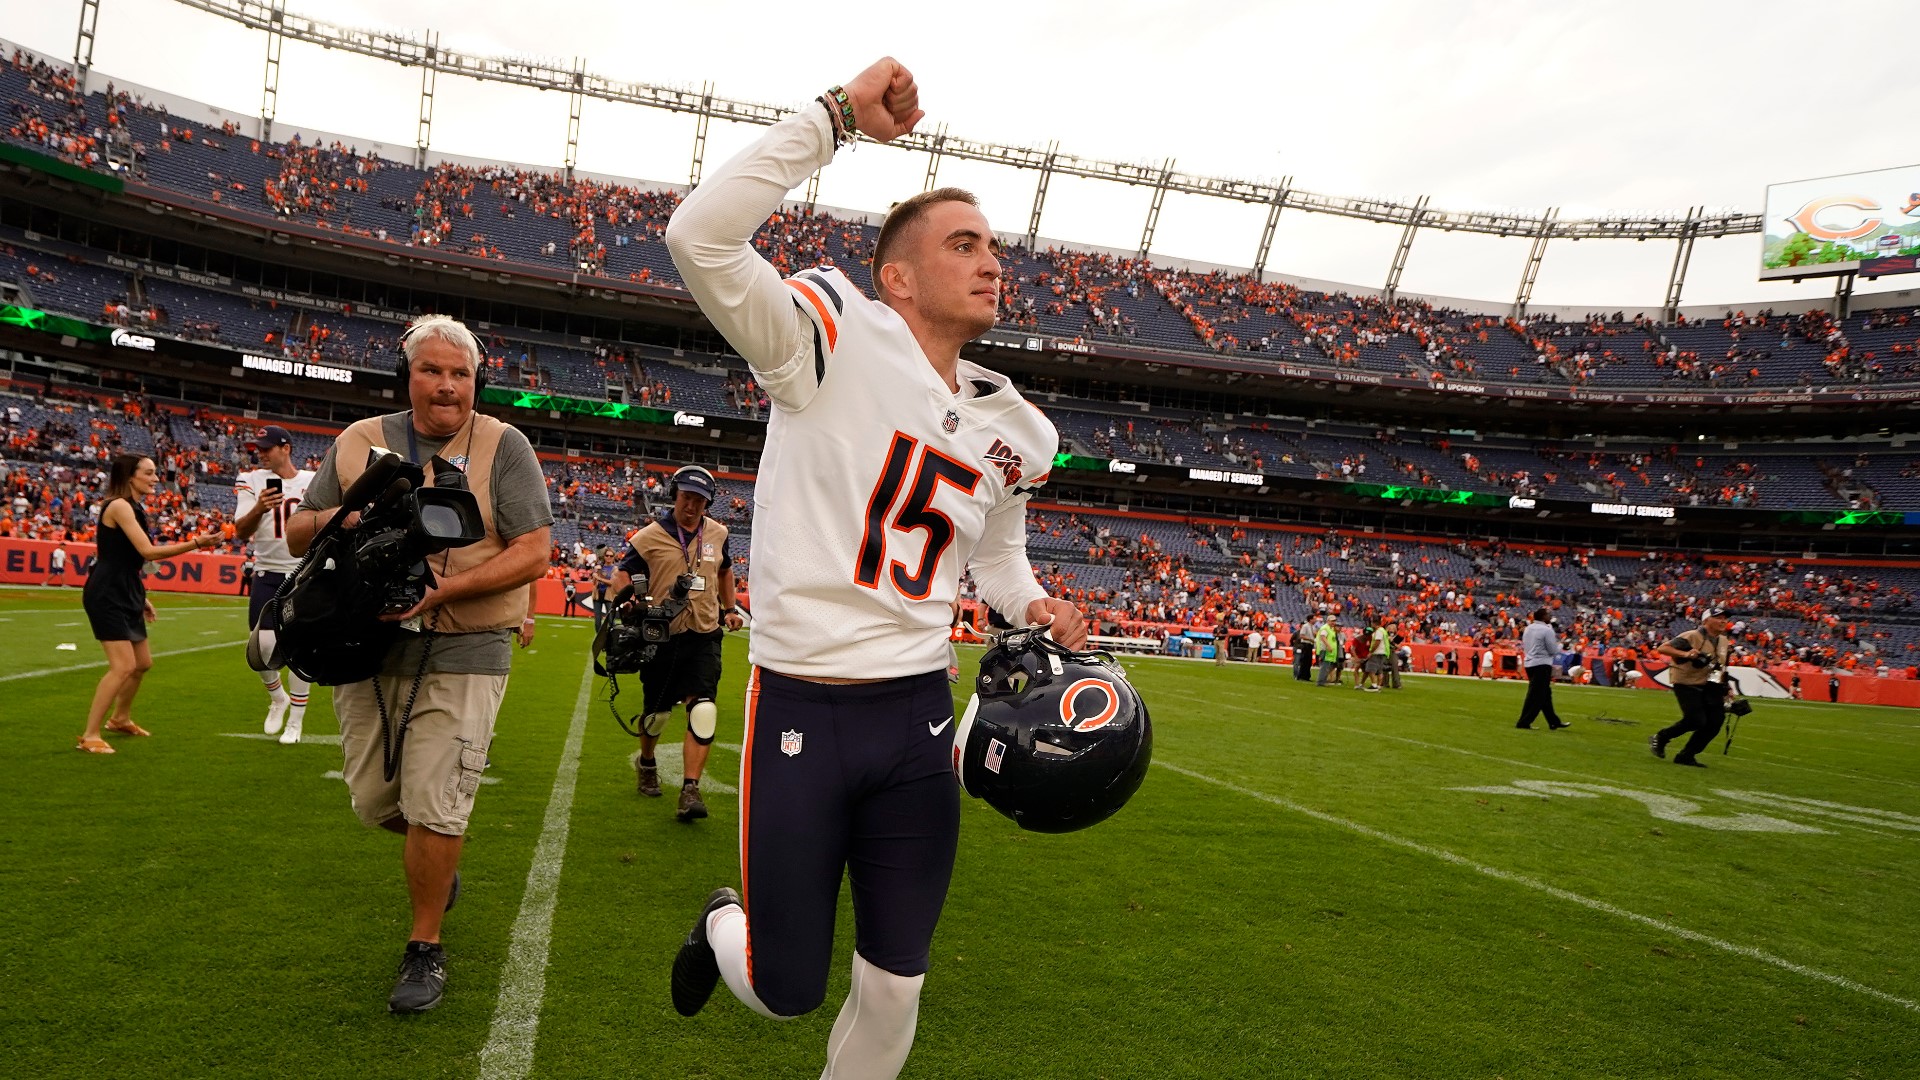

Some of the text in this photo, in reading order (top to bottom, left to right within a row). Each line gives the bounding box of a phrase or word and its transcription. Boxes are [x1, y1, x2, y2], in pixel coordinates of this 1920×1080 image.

[1057, 342, 1088, 352] BOWLEN
[242, 354, 353, 383] MANAGED IT SERVICES
[1286, 369, 1310, 377] MILLER
[1350, 375, 1381, 384] FLETCHER
[1447, 383, 1485, 393] UPCHURCH
[1189, 468, 1264, 485] MANAGED IT SERVICES
[854, 429, 983, 600] 15
[1591, 503, 1675, 518] MANAGED IT SERVICES
